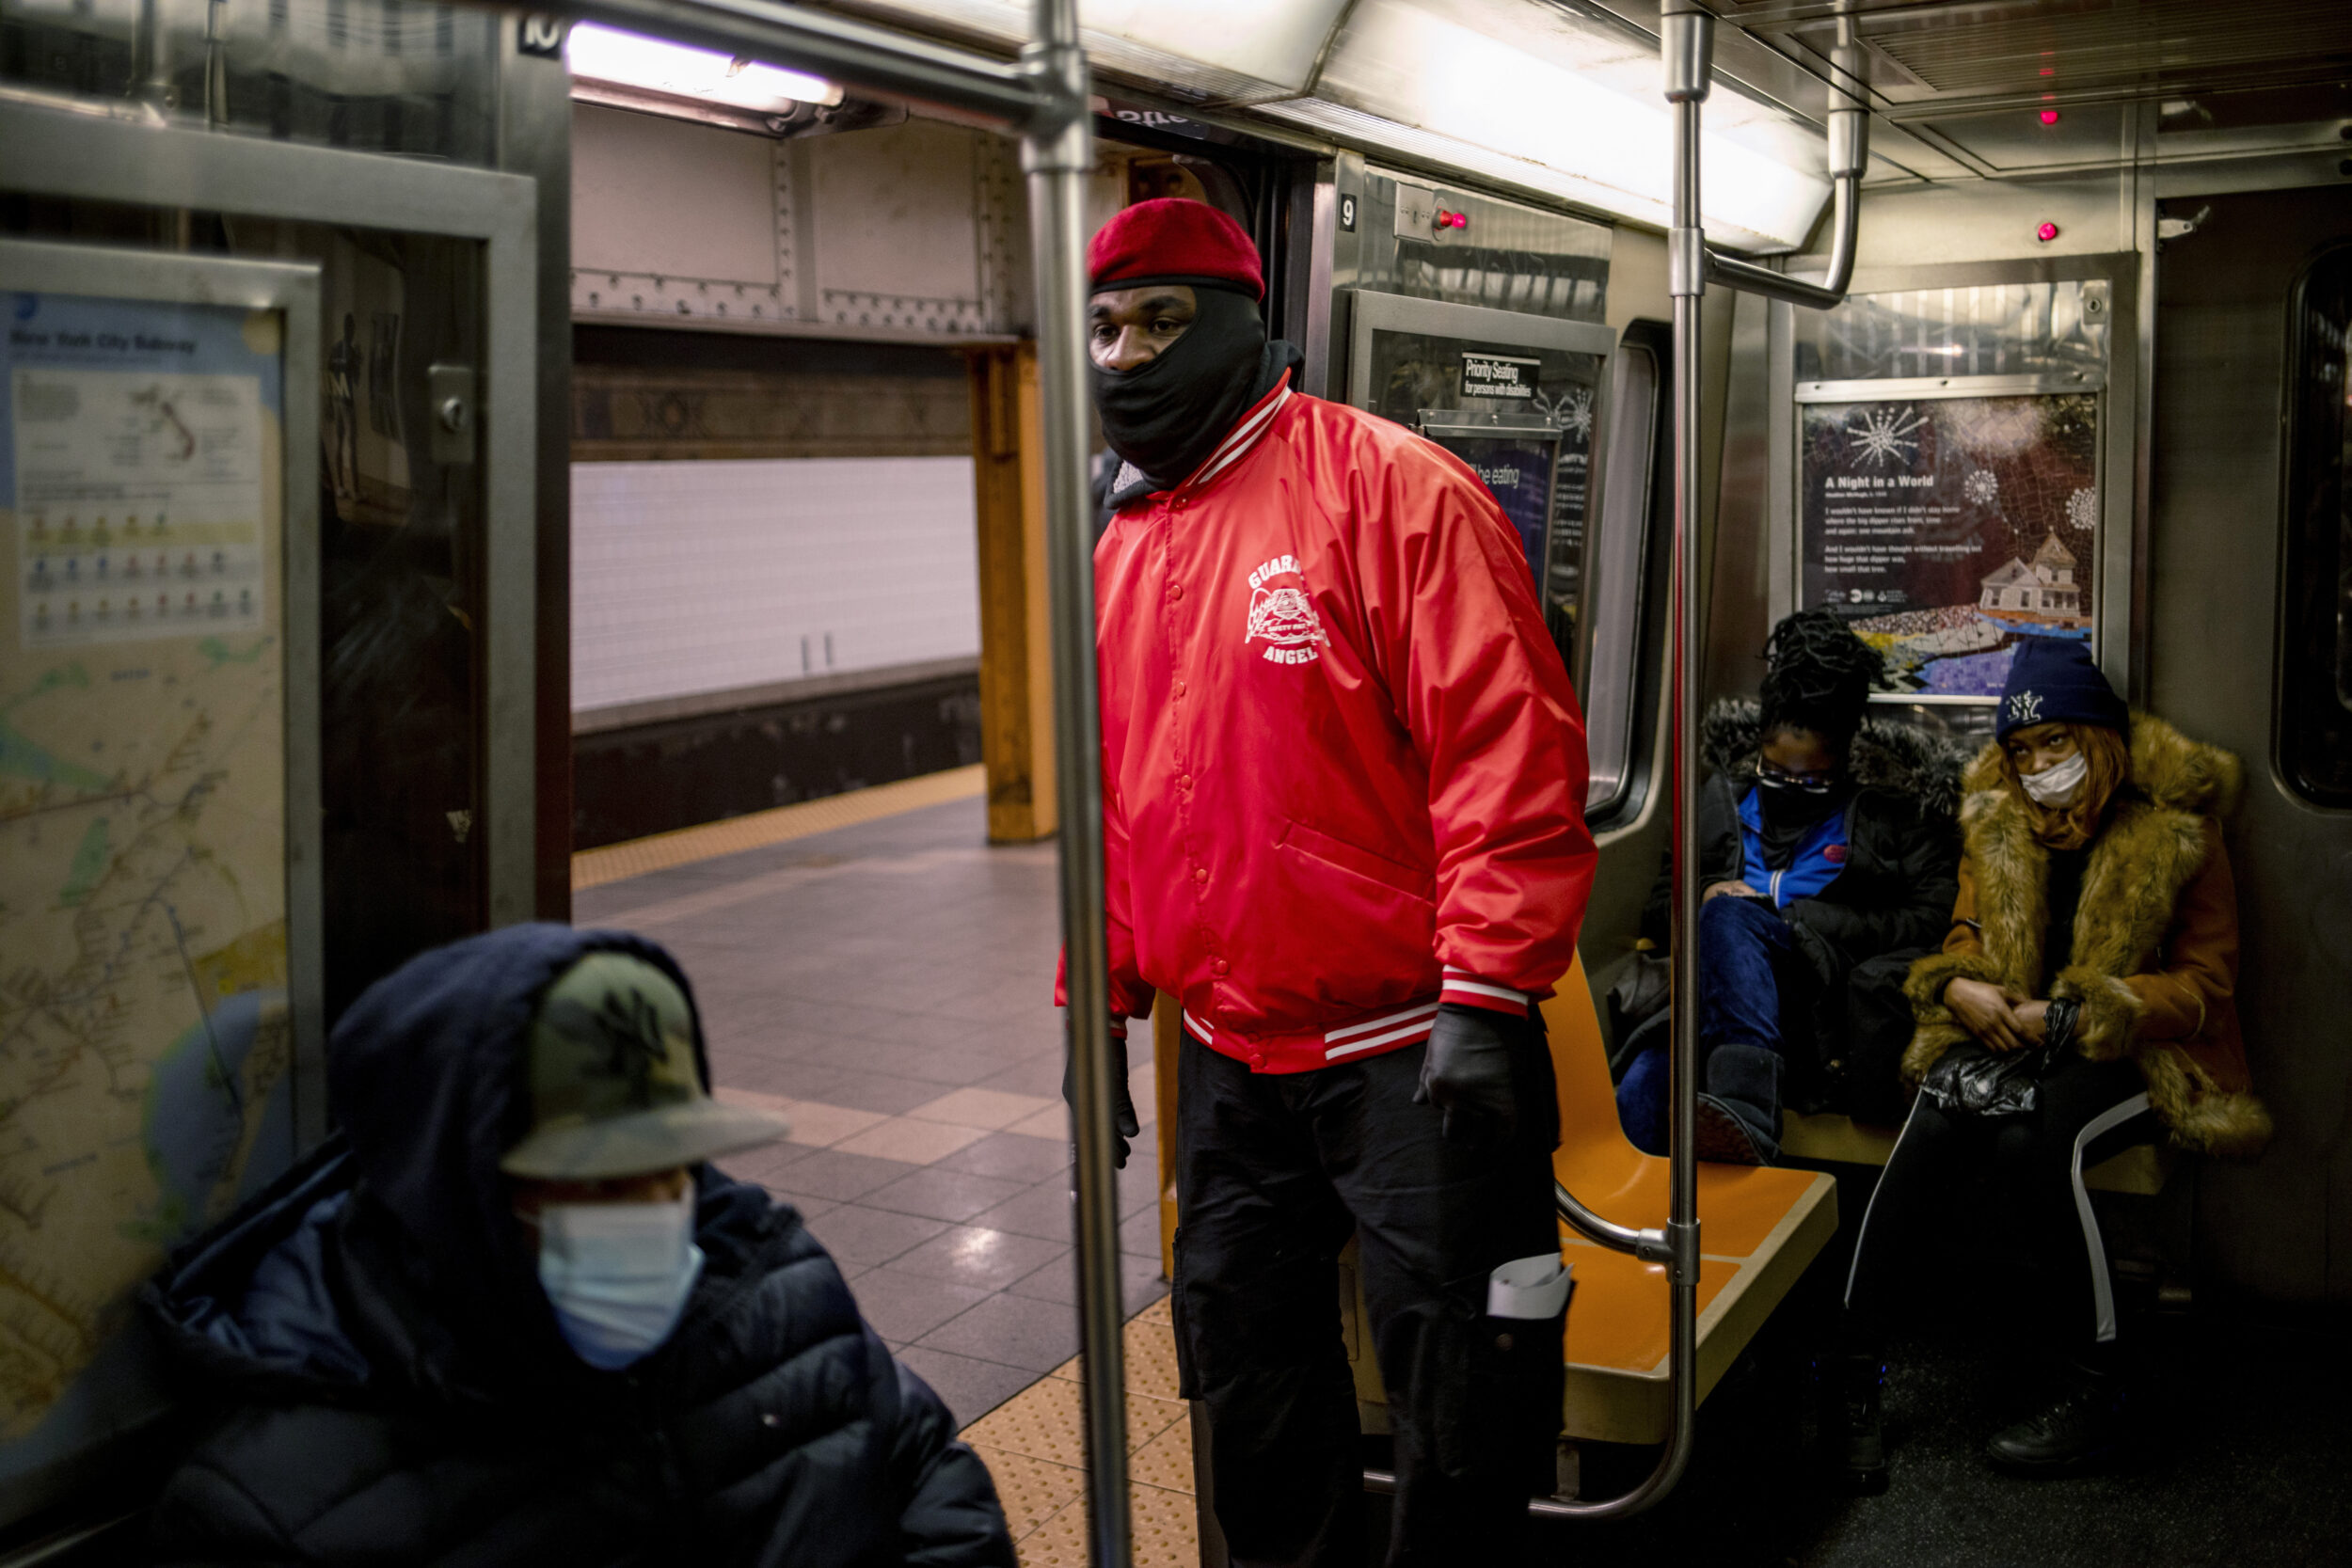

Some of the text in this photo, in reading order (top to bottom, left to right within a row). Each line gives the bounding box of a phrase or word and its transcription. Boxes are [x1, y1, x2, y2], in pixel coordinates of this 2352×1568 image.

[1343, 199, 1354, 226] 9
[1465, 358, 1518, 385] Priority Seating
[1465, 380, 1532, 397] for persons with disabilities
[1492, 464, 1520, 489] eating
[1824, 475, 1934, 490] A Night in a World
[1263, 645, 1319, 665] ANGEL
